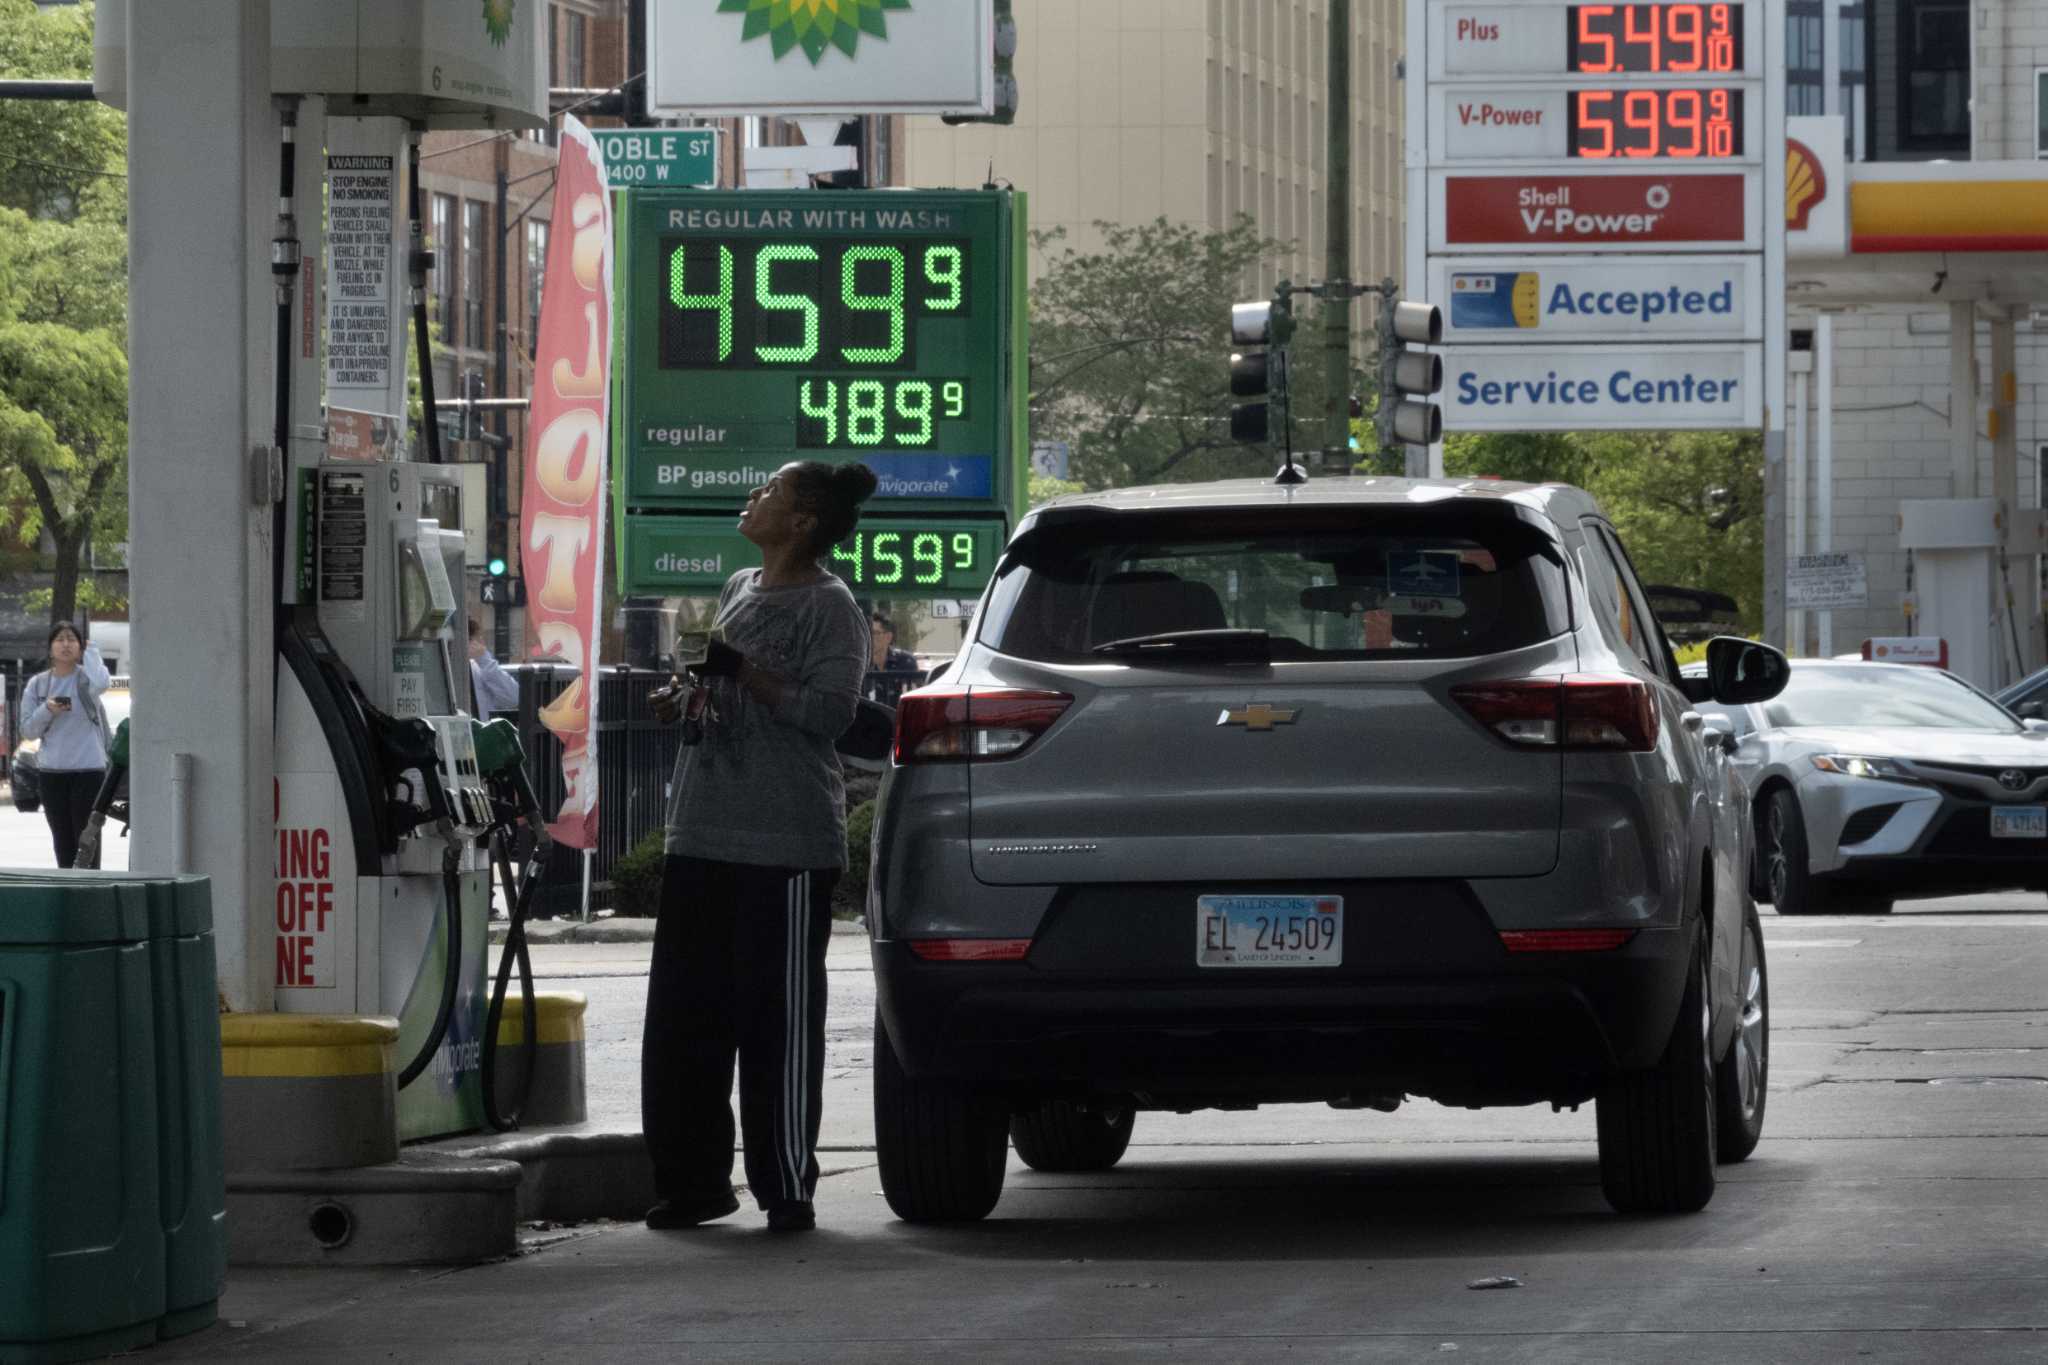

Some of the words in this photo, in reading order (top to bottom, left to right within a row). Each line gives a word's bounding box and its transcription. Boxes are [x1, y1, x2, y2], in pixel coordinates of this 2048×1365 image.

[1458, 19, 1499, 41] Plus
[1577, 5, 1703, 73] 5.49
[432, 66, 441, 91] 6
[1458, 104, 1543, 126] V-Power
[1577, 90, 1703, 158] 5.99
[689, 140, 710, 156] ST
[331, 157, 390, 169] WARNING
[606, 164, 646, 180] 1400
[656, 164, 669, 180] W
[333, 176, 355, 188] STOP
[356, 176, 390, 188] ENGINE
[333, 188, 346, 200] NO
[347, 188, 389, 200] SMOKING
[1518, 188, 1570, 206] Shell
[330, 206, 361, 218] PERSONS
[362, 206, 391, 218] FUELING
[668, 209, 793, 228] REGULAR
[803, 209, 865, 228] WITH
[876, 209, 950, 228] WASH
[333, 220, 364, 232] VEHICLES
[365, 220, 387, 232] SHALL
[1520, 209, 1658, 234] V-Power
[355, 233, 372, 244] WITH
[363, 246, 371, 258] AT
[374, 246, 385, 258] THE
[362, 259, 385, 270] WHILE
[336, 272, 364, 283] FUELING
[365, 272, 373, 283] IS
[374, 272, 382, 283] IN
[332, 305, 340, 317] IT
[341, 305, 349, 317] IS
[350, 305, 386, 317] UNLAWFUL
[1547, 281, 1733, 323] Accepted
[330, 319, 345, 330] AND
[346, 319, 387, 330] DANGEROUS
[332, 332, 346, 343] FOR
[347, 332, 374, 343] ANYONE
[376, 332, 385, 343] TO
[329, 358, 343, 369] INTO
[345, 358, 387, 369] UNAPPROVED
[1457, 371, 1600, 405] Service
[1608, 371, 1739, 404] Center
[647, 425, 727, 446] regular
[389, 469, 400, 493] 6
[657, 465, 687, 484] BP
[879, 479, 949, 497] nvigorate
[304, 482, 315, 590] diesel
[655, 553, 722, 572] diesel
[401, 678, 417, 697] PAY
[273, 828, 330, 879] ING
[276, 881, 334, 932] OFF
[1206, 916, 1236, 951] EL
[1255, 916, 1336, 951] 24509
